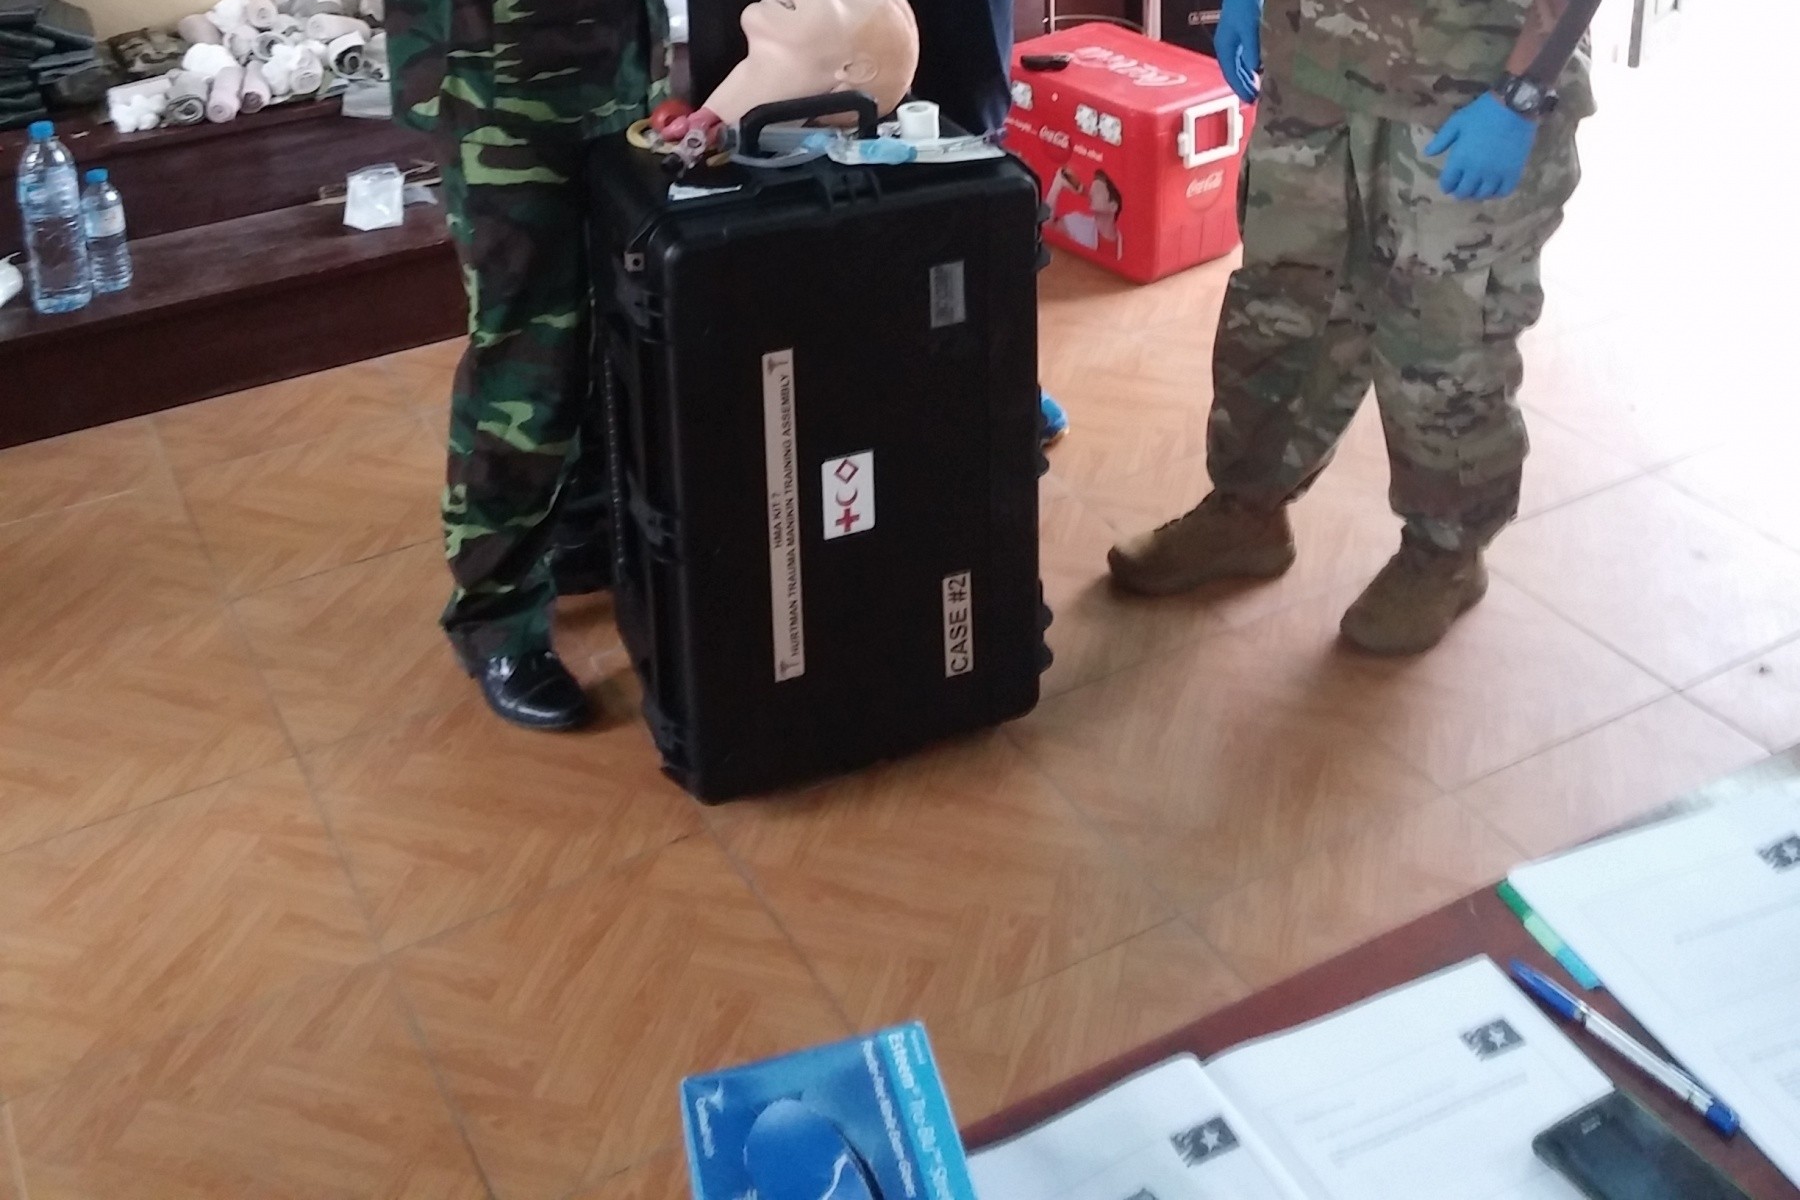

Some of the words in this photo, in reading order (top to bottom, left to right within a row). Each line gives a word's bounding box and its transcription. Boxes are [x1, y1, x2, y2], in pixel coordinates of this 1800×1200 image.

[780, 375, 792, 437] ASSEMBLY
[782, 440, 793, 495] TRAINING
[785, 498, 795, 547] MANIKIN
[786, 547, 797, 598] TRAUMA
[947, 575, 968, 604] #2
[949, 607, 969, 673] CASE
